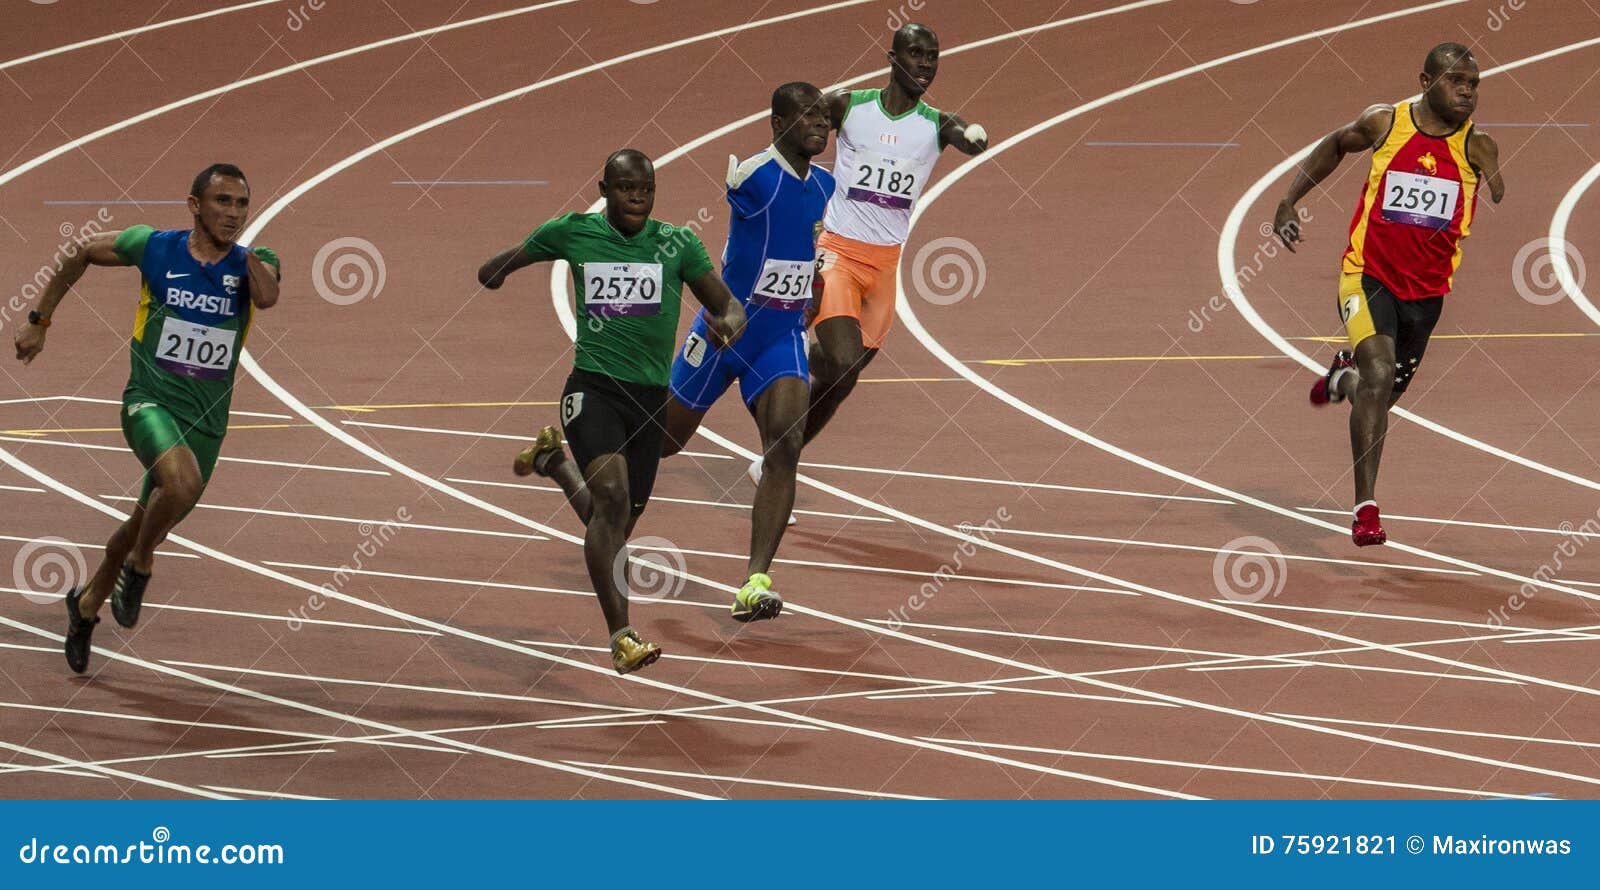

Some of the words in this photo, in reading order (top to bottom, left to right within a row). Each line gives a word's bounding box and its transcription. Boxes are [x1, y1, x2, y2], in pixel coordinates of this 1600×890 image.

[857, 165, 914, 195] 2182
[1389, 185, 1448, 214] 2591
[591, 276, 656, 300] 2570
[761, 272, 811, 296] 2551
[166, 287, 235, 316] BRASIL
[164, 334, 228, 366] 2102
[686, 337, 699, 358] 7
[565, 395, 574, 419] 8
